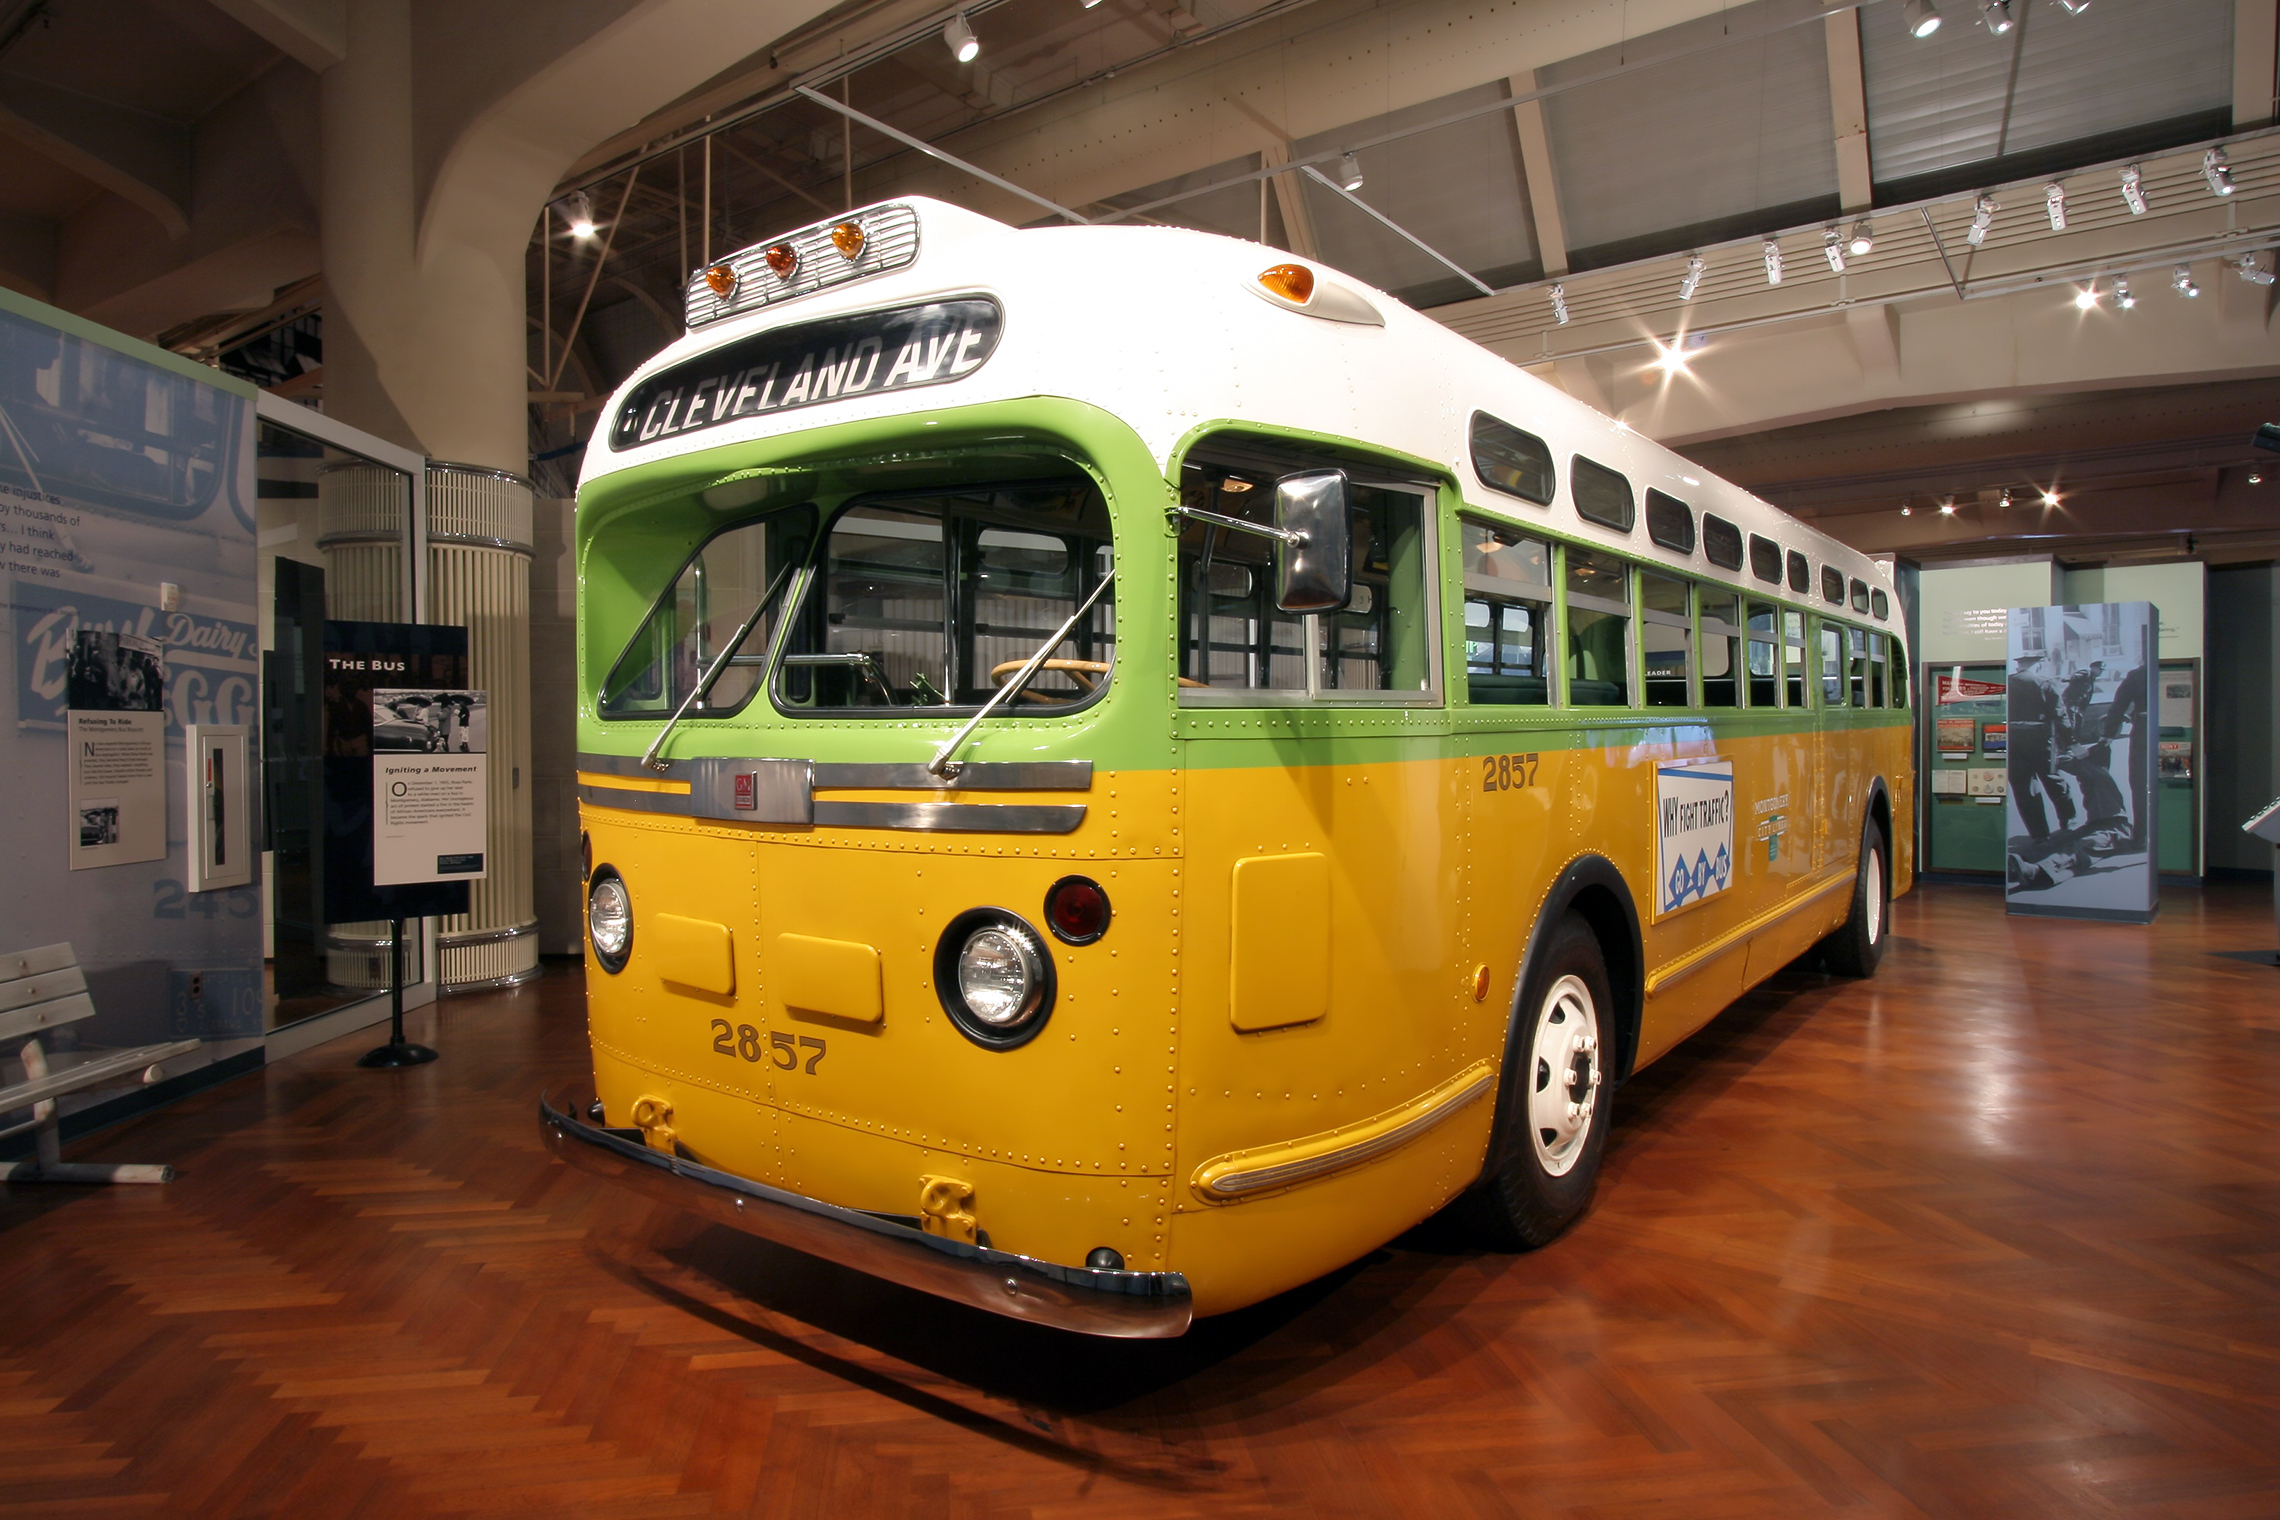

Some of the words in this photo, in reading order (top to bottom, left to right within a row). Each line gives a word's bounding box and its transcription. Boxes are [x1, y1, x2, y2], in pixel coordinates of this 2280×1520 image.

[640, 334, 884, 442] CLEVELAND
[884, 312, 984, 388] AVE
[13, 487, 60, 505] injustices
[14, 505, 67, 524] thousands
[70, 516, 81, 526] of
[21, 525, 24, 535] I
[27, 526, 55, 540] think
[9, 541, 30, 555] had
[33, 547, 74, 561] reached
[8, 561, 38, 575] there
[40, 567, 60, 578] was
[161, 613, 248, 659] Dairy
[329, 659, 365, 670] THE
[372, 660, 405, 671] BUS
[79, 718, 108, 726] Refusing
[385, 767, 422, 775] Igniting
[1482, 752, 1539, 792] 2857
[1662, 796, 1679, 838] WHY
[1680, 801, 1699, 833] FIGHT
[1699, 790, 1730, 828] TRAFFIC?
[1674, 868, 1685, 895] GO
[1697, 861, 1707, 887] BY
[1715, 854, 1728, 880] BUS
[711, 1018, 827, 1076] 2857
